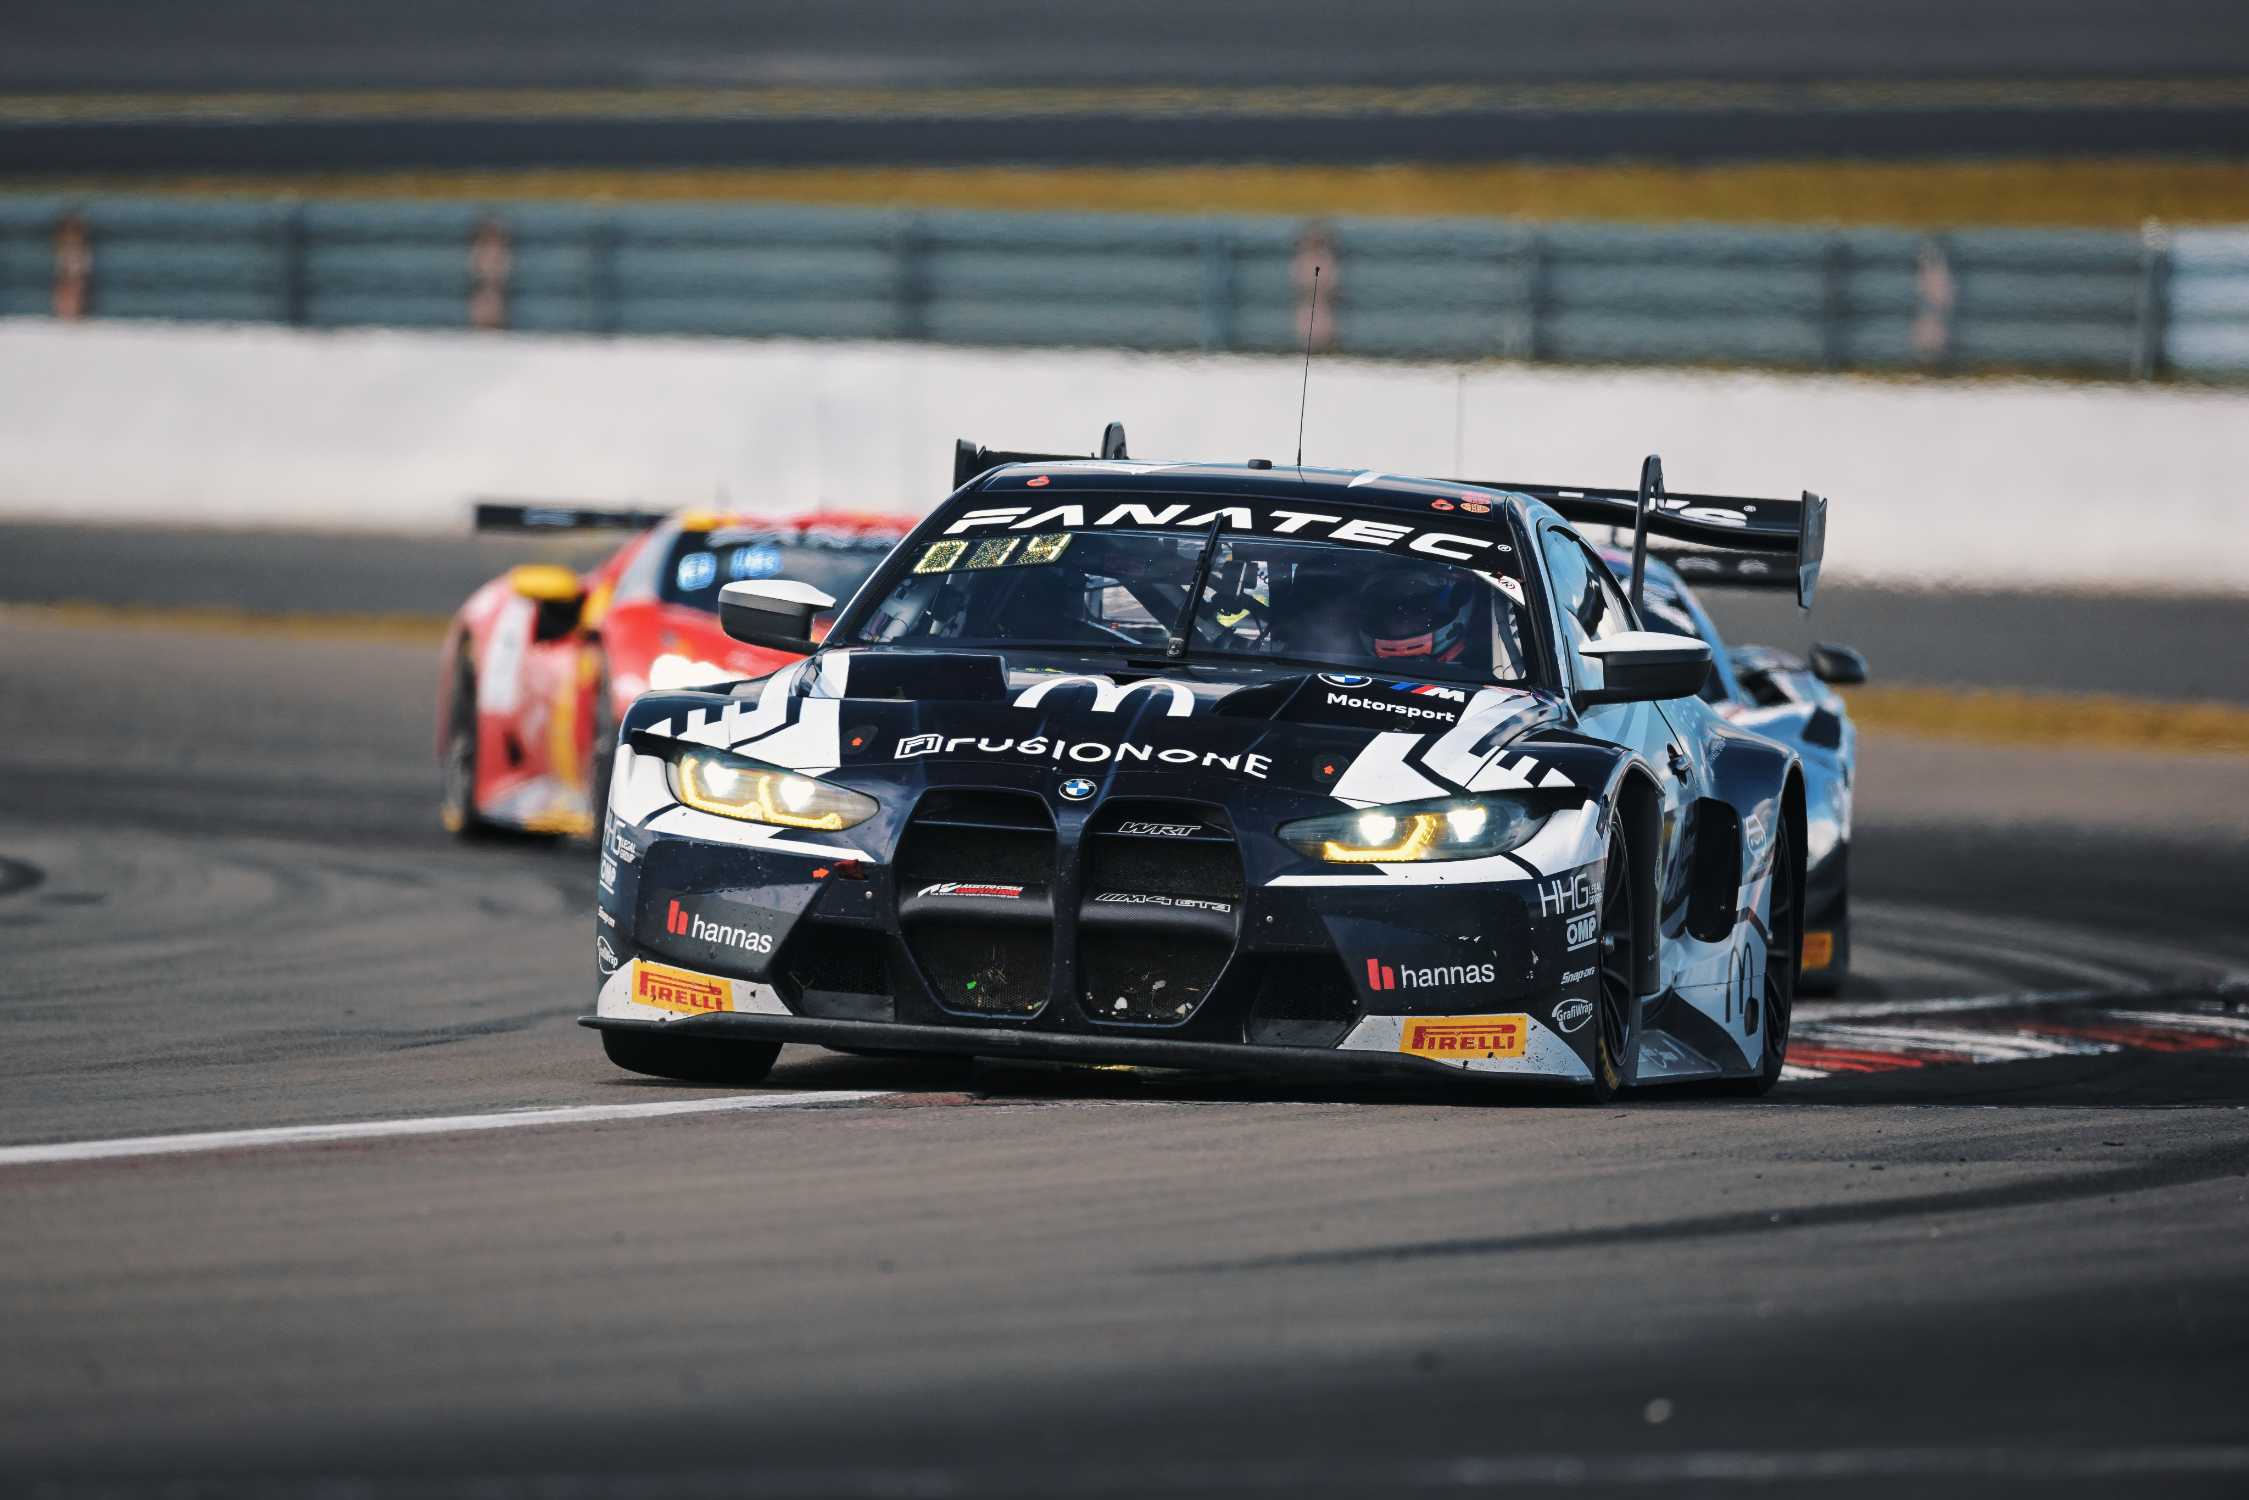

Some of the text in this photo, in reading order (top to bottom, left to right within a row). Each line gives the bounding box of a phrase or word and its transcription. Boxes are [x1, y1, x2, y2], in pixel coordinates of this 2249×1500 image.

[943, 503, 1494, 561] FANATEC
[1327, 692, 1455, 722] Motorsport
[1119, 821, 1202, 836] WRT
[1537, 872, 1588, 917] HHG
[692, 913, 773, 953] hannas
[1567, 917, 1596, 944] OMP
[638, 970, 723, 1011] PIRELLI
[1400, 963, 1496, 988] hannas
[1411, 1024, 1517, 1050] PIRELLI
